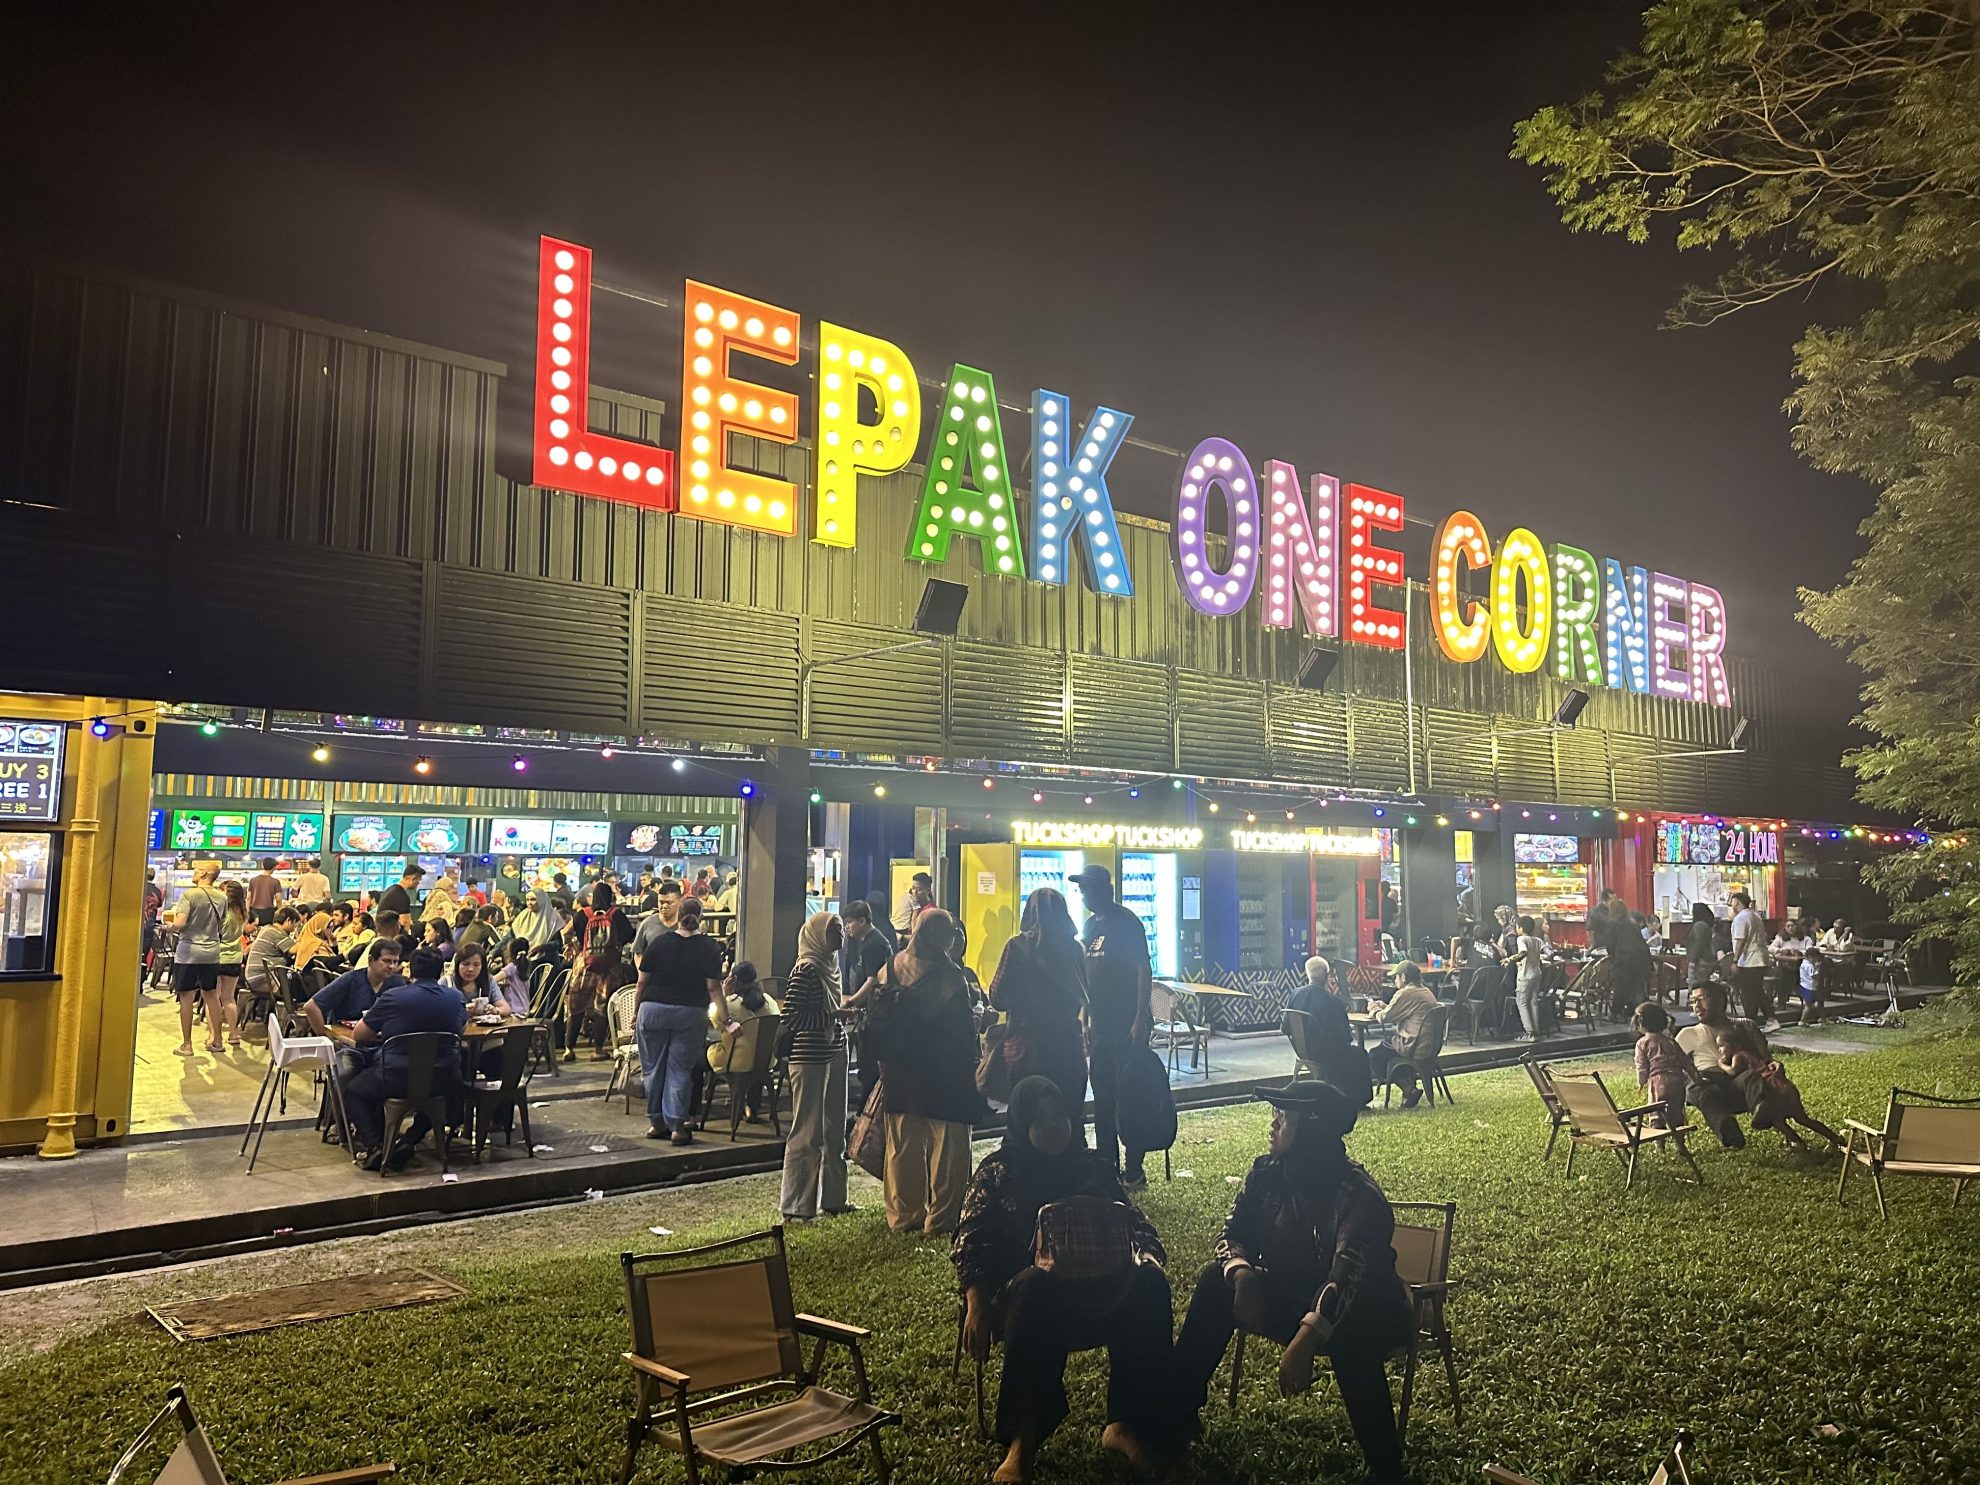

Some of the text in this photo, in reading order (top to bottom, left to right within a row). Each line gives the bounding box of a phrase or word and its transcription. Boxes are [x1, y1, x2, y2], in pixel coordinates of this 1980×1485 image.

[532, 234, 1731, 708] LEPAK ONE CORNER
[0, 763, 49, 780] UY 3
[38, 783, 48, 799] 1
[0, 802, 42, 814] 三送一
[1011, 820, 1203, 847] TUCKSHOP TUCKSHOP
[1725, 829, 1745, 863] 24
[1750, 831, 1778, 863] HOUR
